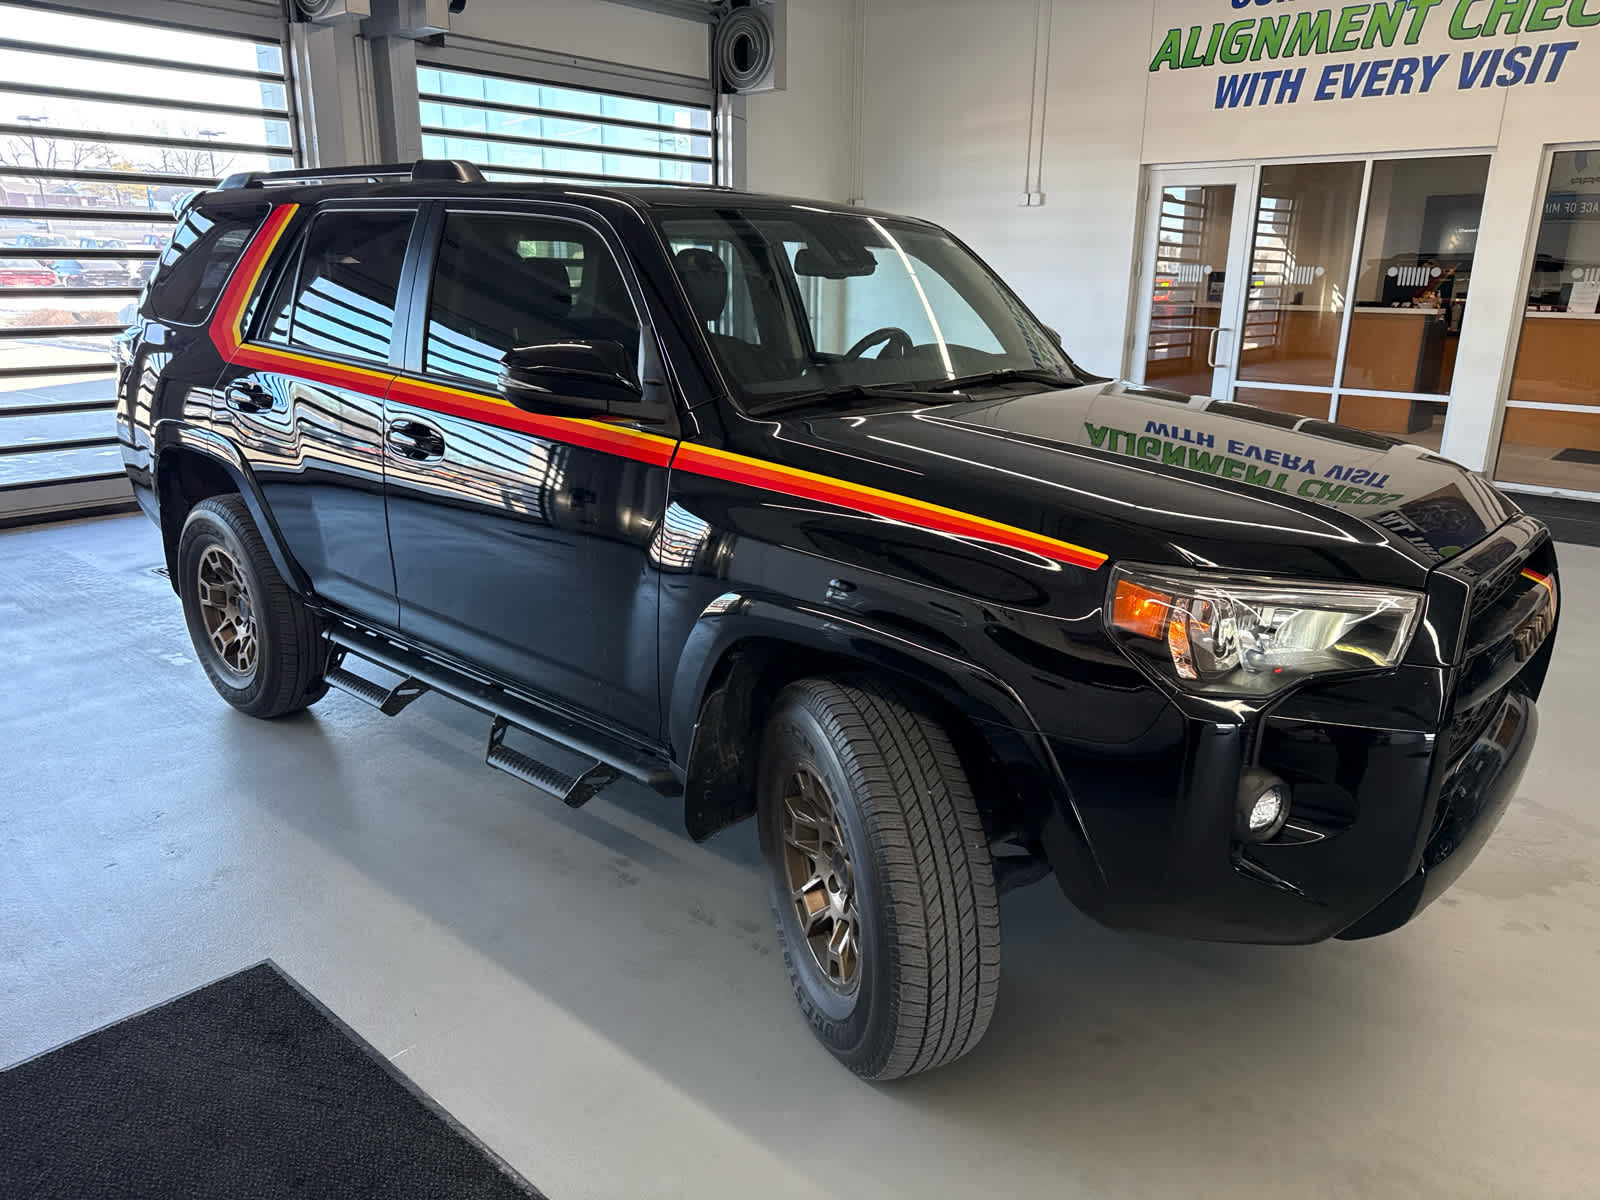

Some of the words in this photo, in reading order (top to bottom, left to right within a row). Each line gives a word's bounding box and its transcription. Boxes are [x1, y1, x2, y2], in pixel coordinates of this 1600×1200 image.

[1149, 0, 1442, 72] ALIGNMENT
[1214, 68, 1306, 109] WITH
[1313, 54, 1450, 101] EVERY
[1458, 41, 1579, 90] VISIT
